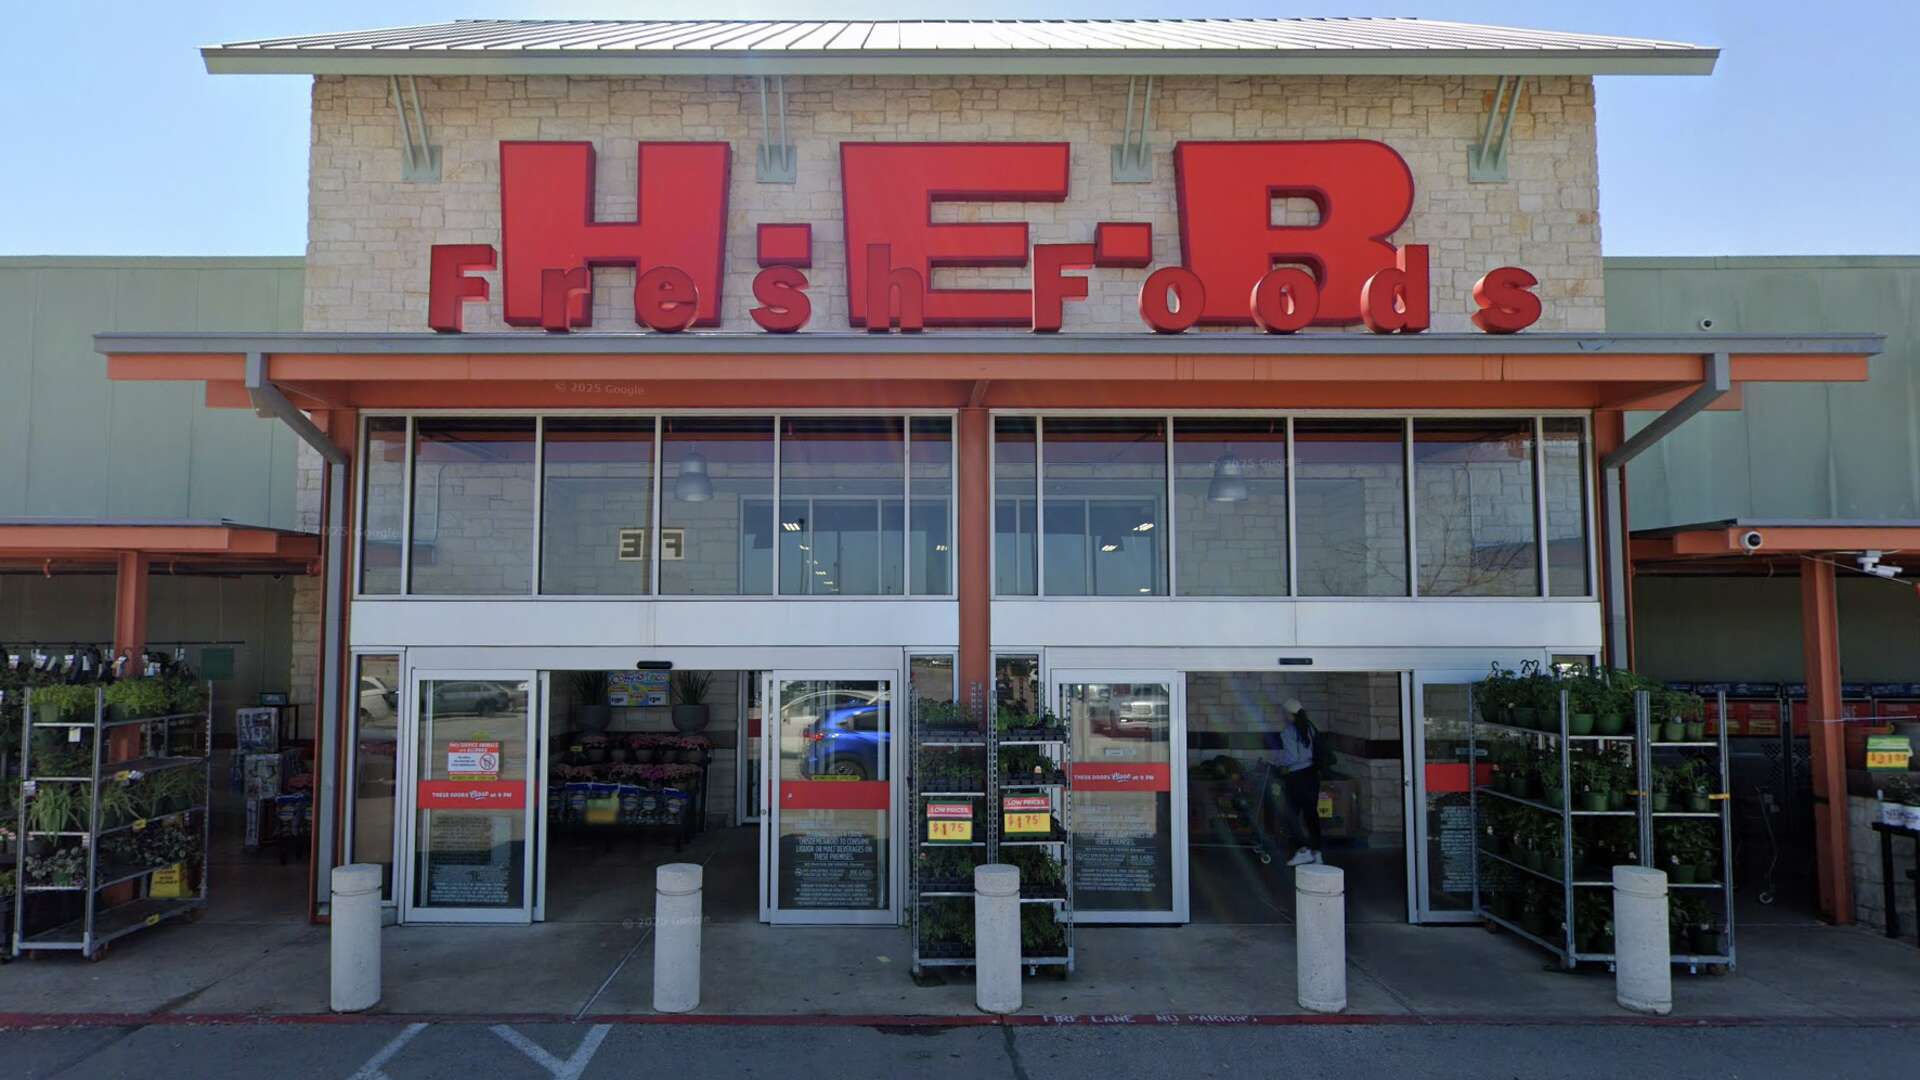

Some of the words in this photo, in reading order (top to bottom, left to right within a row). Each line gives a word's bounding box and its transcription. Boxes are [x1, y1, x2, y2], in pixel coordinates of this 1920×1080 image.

[428, 243, 926, 334] Fresh
[1032, 243, 1543, 335] Foods
[1091, 1014, 1136, 1024] LANE
[1155, 1014, 1179, 1024] NO
